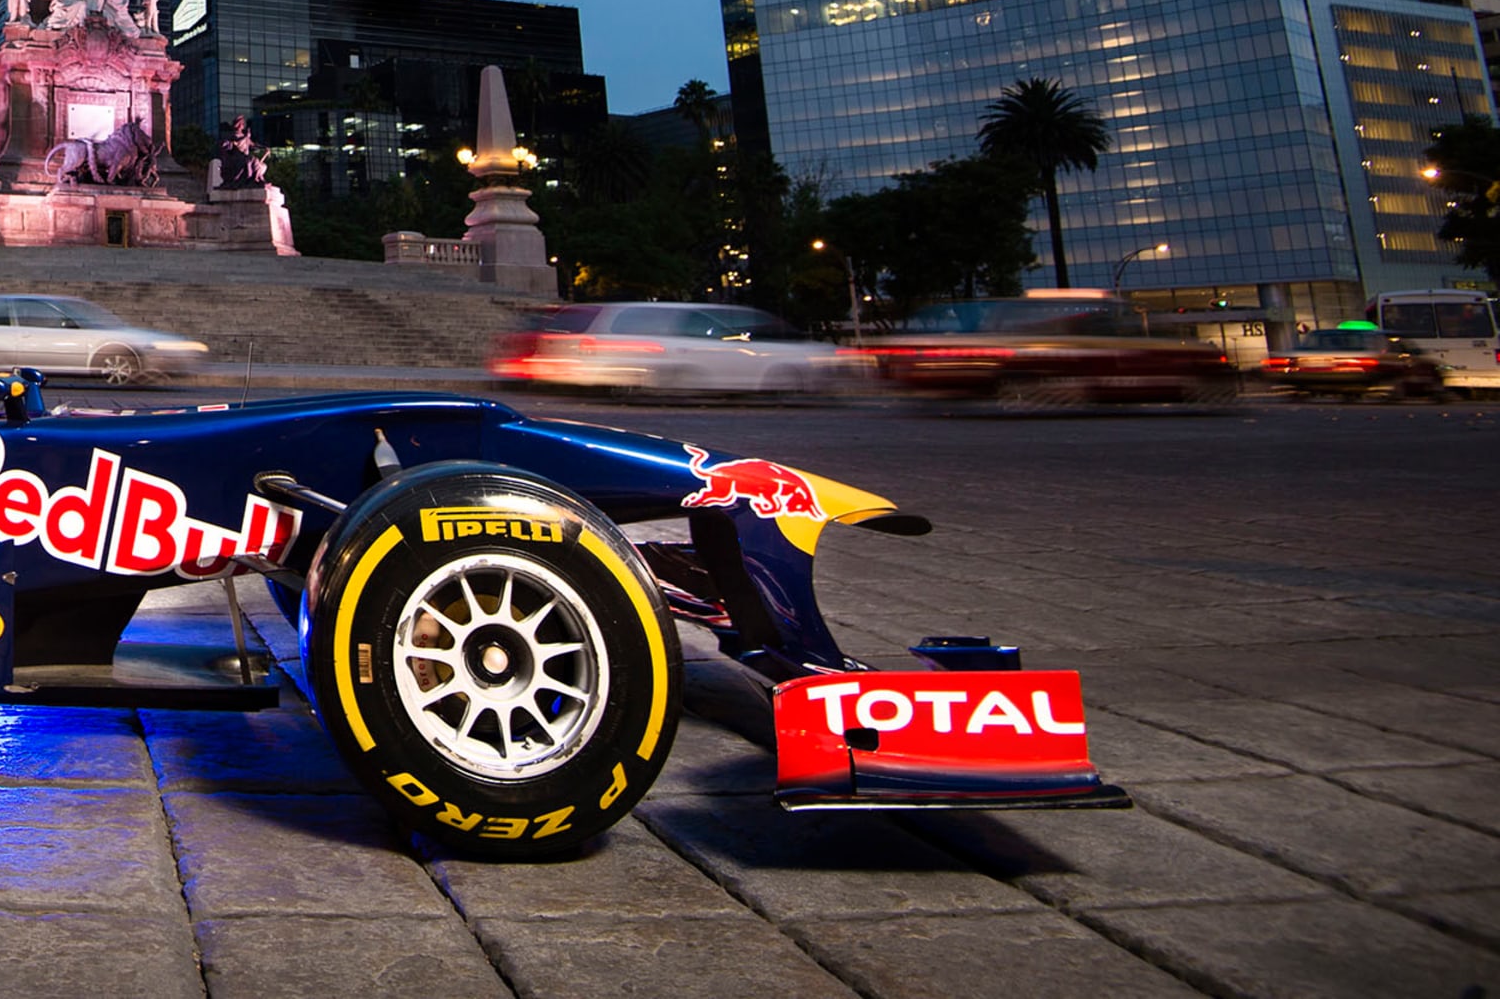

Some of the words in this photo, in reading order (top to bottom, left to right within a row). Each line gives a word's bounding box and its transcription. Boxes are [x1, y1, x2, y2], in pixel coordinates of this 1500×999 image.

[106, 467, 303, 580] Bull
[420, 506, 563, 543] PIRELLI
[807, 682, 1086, 735] TOTAL
[386, 772, 575, 840] ZERO
[600, 762, 629, 810] P
